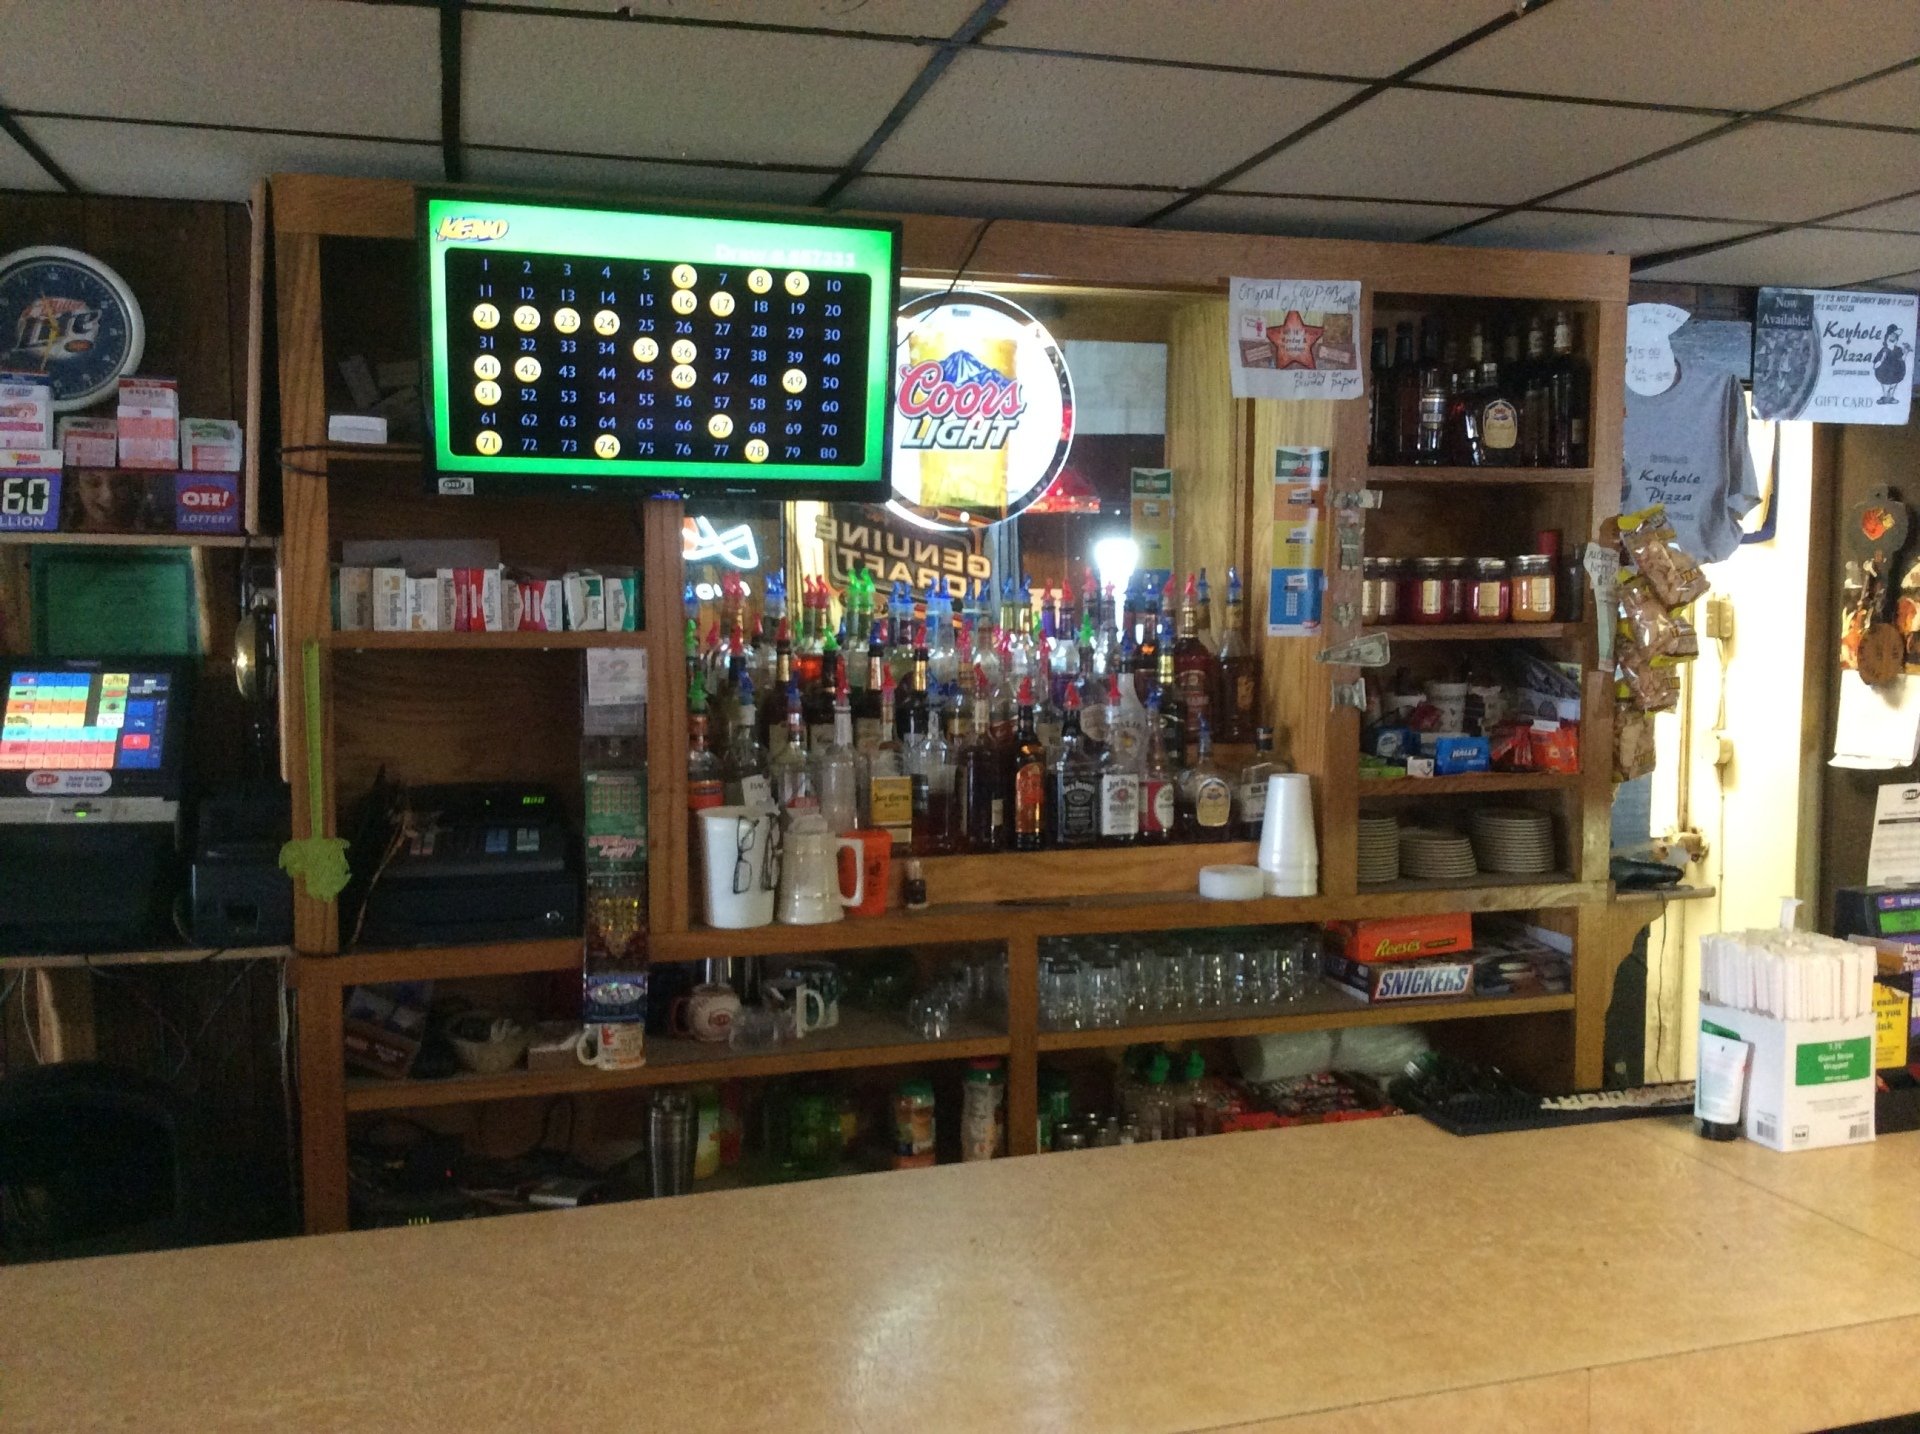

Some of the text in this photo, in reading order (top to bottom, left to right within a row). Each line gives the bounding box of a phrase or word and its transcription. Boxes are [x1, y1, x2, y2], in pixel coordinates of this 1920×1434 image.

[437, 217, 509, 241] KENO
[826, 279, 842, 292] 10
[480, 284, 842, 317] 11 12 13 14 15 16 17 18 19 20
[1775, 296, 1798, 309] Now
[479, 310, 841, 341] 21 22 23 24 25 26 27 28 29 30
[1761, 313, 1810, 327] Available!
[1822, 320, 1882, 345] Keyhole
[479, 335, 841, 365] 31 32 33 34 35 36 37 38 39 40
[1828, 343, 1873, 367] Pizza
[480, 361, 840, 389] 41 42 43 44 45 46 47 48 49 50
[480, 386, 839, 413] 51 52 53 54 55 56 57 58 59 60
[897, 360, 1027, 417] Coors
[1814, 395, 1873, 408] GIFT CARD
[480, 412, 838, 436] 61 62 63 64 65 66 67 68 69 70
[900, 414, 1020, 450] LIGHT
[481, 436, 838, 460] 71 72 73 74 75 76 77 78 79 80
[1639, 469, 1701, 487] Keyhole
[182, 490, 230, 508] OH!
[1645, 486, 1693, 503] Pizza
[181, 514, 234, 525] LOTTERY
[1374, 938, 1421, 957] Reese's
[1379, 966, 1470, 997] SNICKERS
